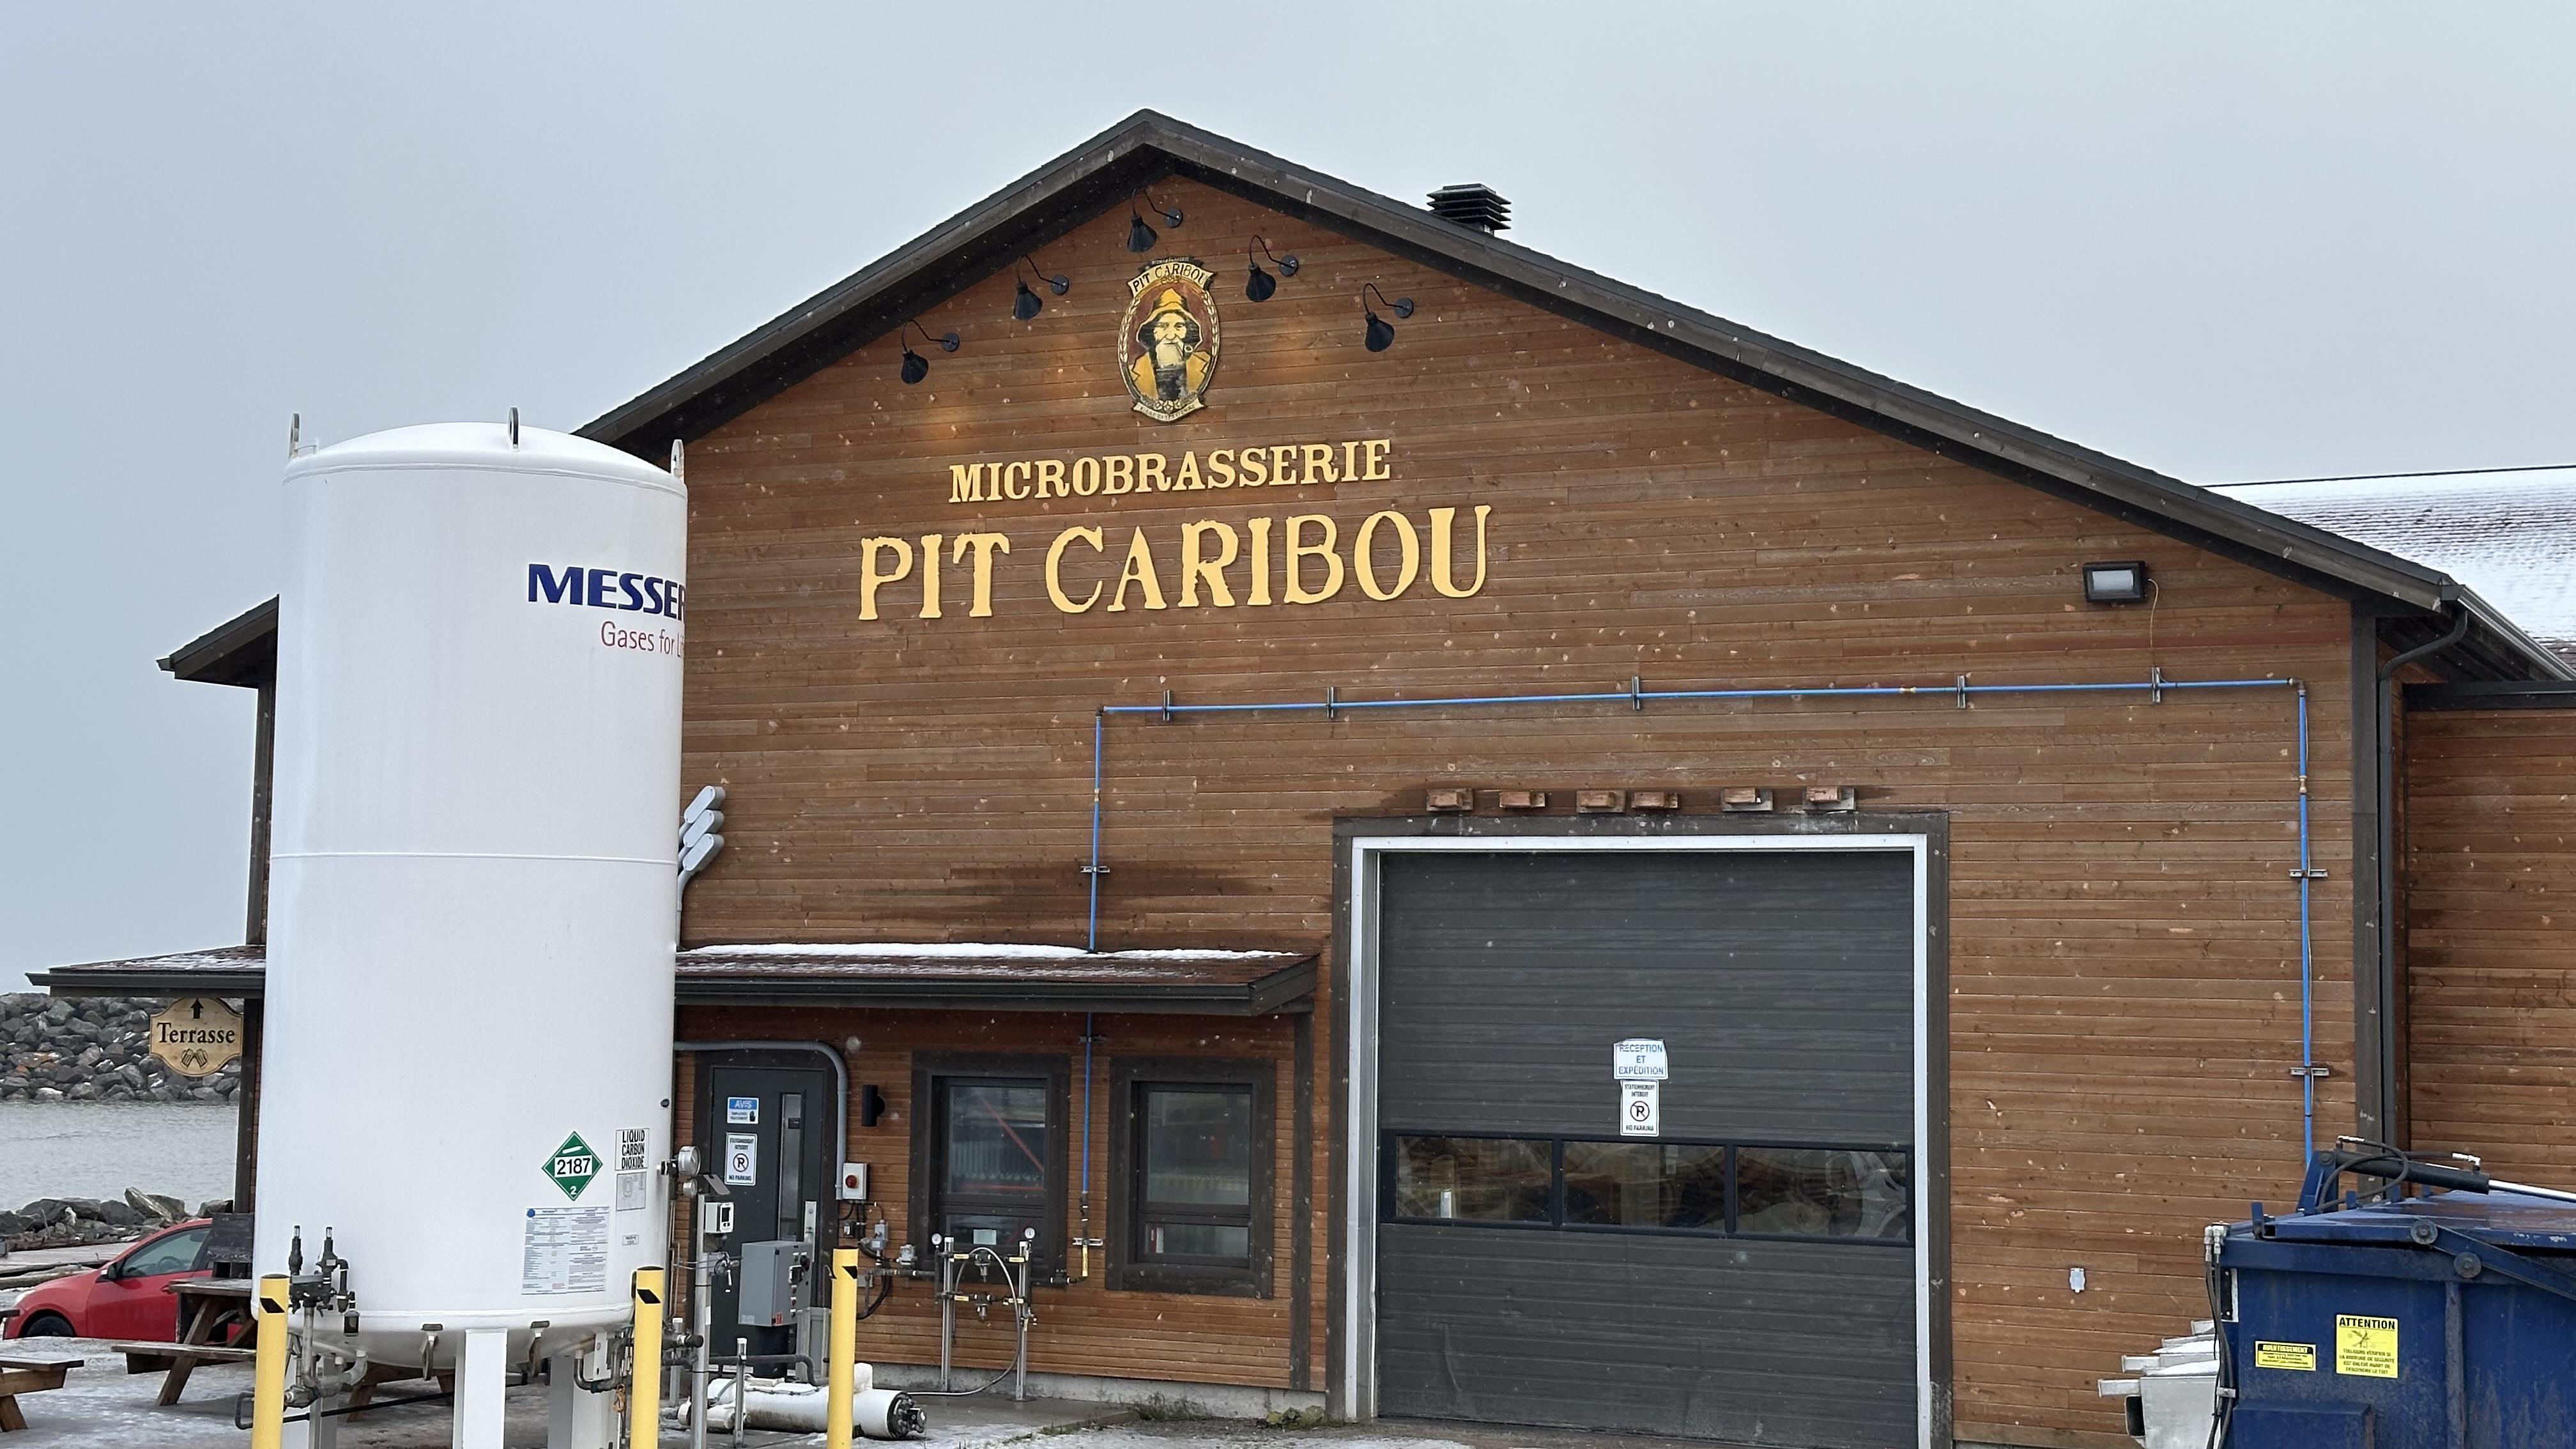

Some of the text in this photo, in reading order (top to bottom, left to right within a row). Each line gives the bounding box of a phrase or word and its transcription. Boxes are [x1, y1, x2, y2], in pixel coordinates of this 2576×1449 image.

[1133, 263, 1208, 292] PIT CARIBOU
[949, 438, 1392, 503] MICROBRASSERIE
[859, 505, 1491, 620] PIT CARIBOU
[528, 564, 686, 621] MESSER
[601, 621, 654, 651] Gases
[659, 629, 675, 656] for
[157, 1022, 235, 1043] Terrasse
[622, 1130, 645, 1142] LIQUID
[622, 1143, 645, 1156] CARBON
[557, 1158, 590, 1174] 2187
[622, 1156, 644, 1169] DIOXIDE
[570, 1186, 576, 1195] 2
[2339, 1317, 2395, 1330] ATTENTION
